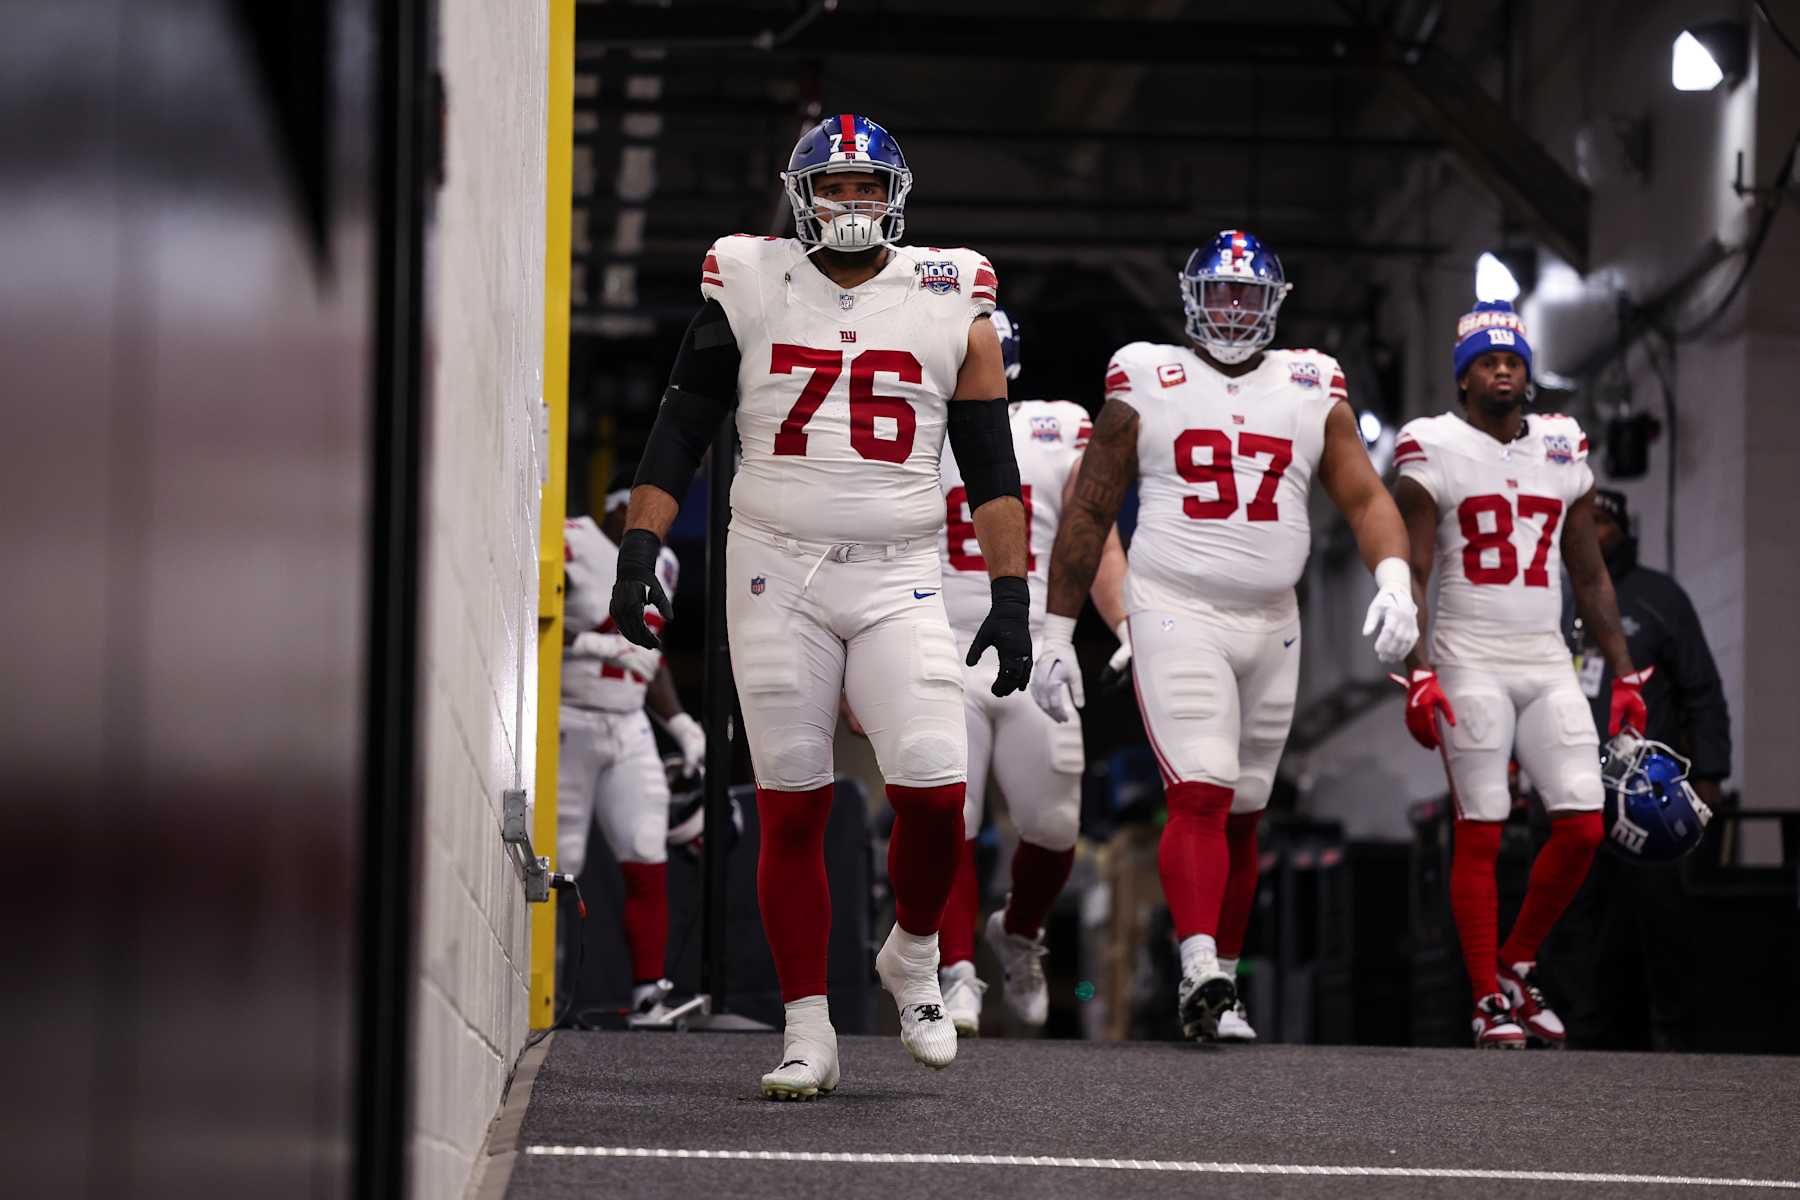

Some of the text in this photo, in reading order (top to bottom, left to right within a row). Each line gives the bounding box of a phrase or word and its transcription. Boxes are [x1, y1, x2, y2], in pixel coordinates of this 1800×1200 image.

[920, 263, 958, 278] 100
[770, 343, 922, 464] 76
[1174, 429, 1293, 521] 97
[1458, 494, 1562, 587] 87
